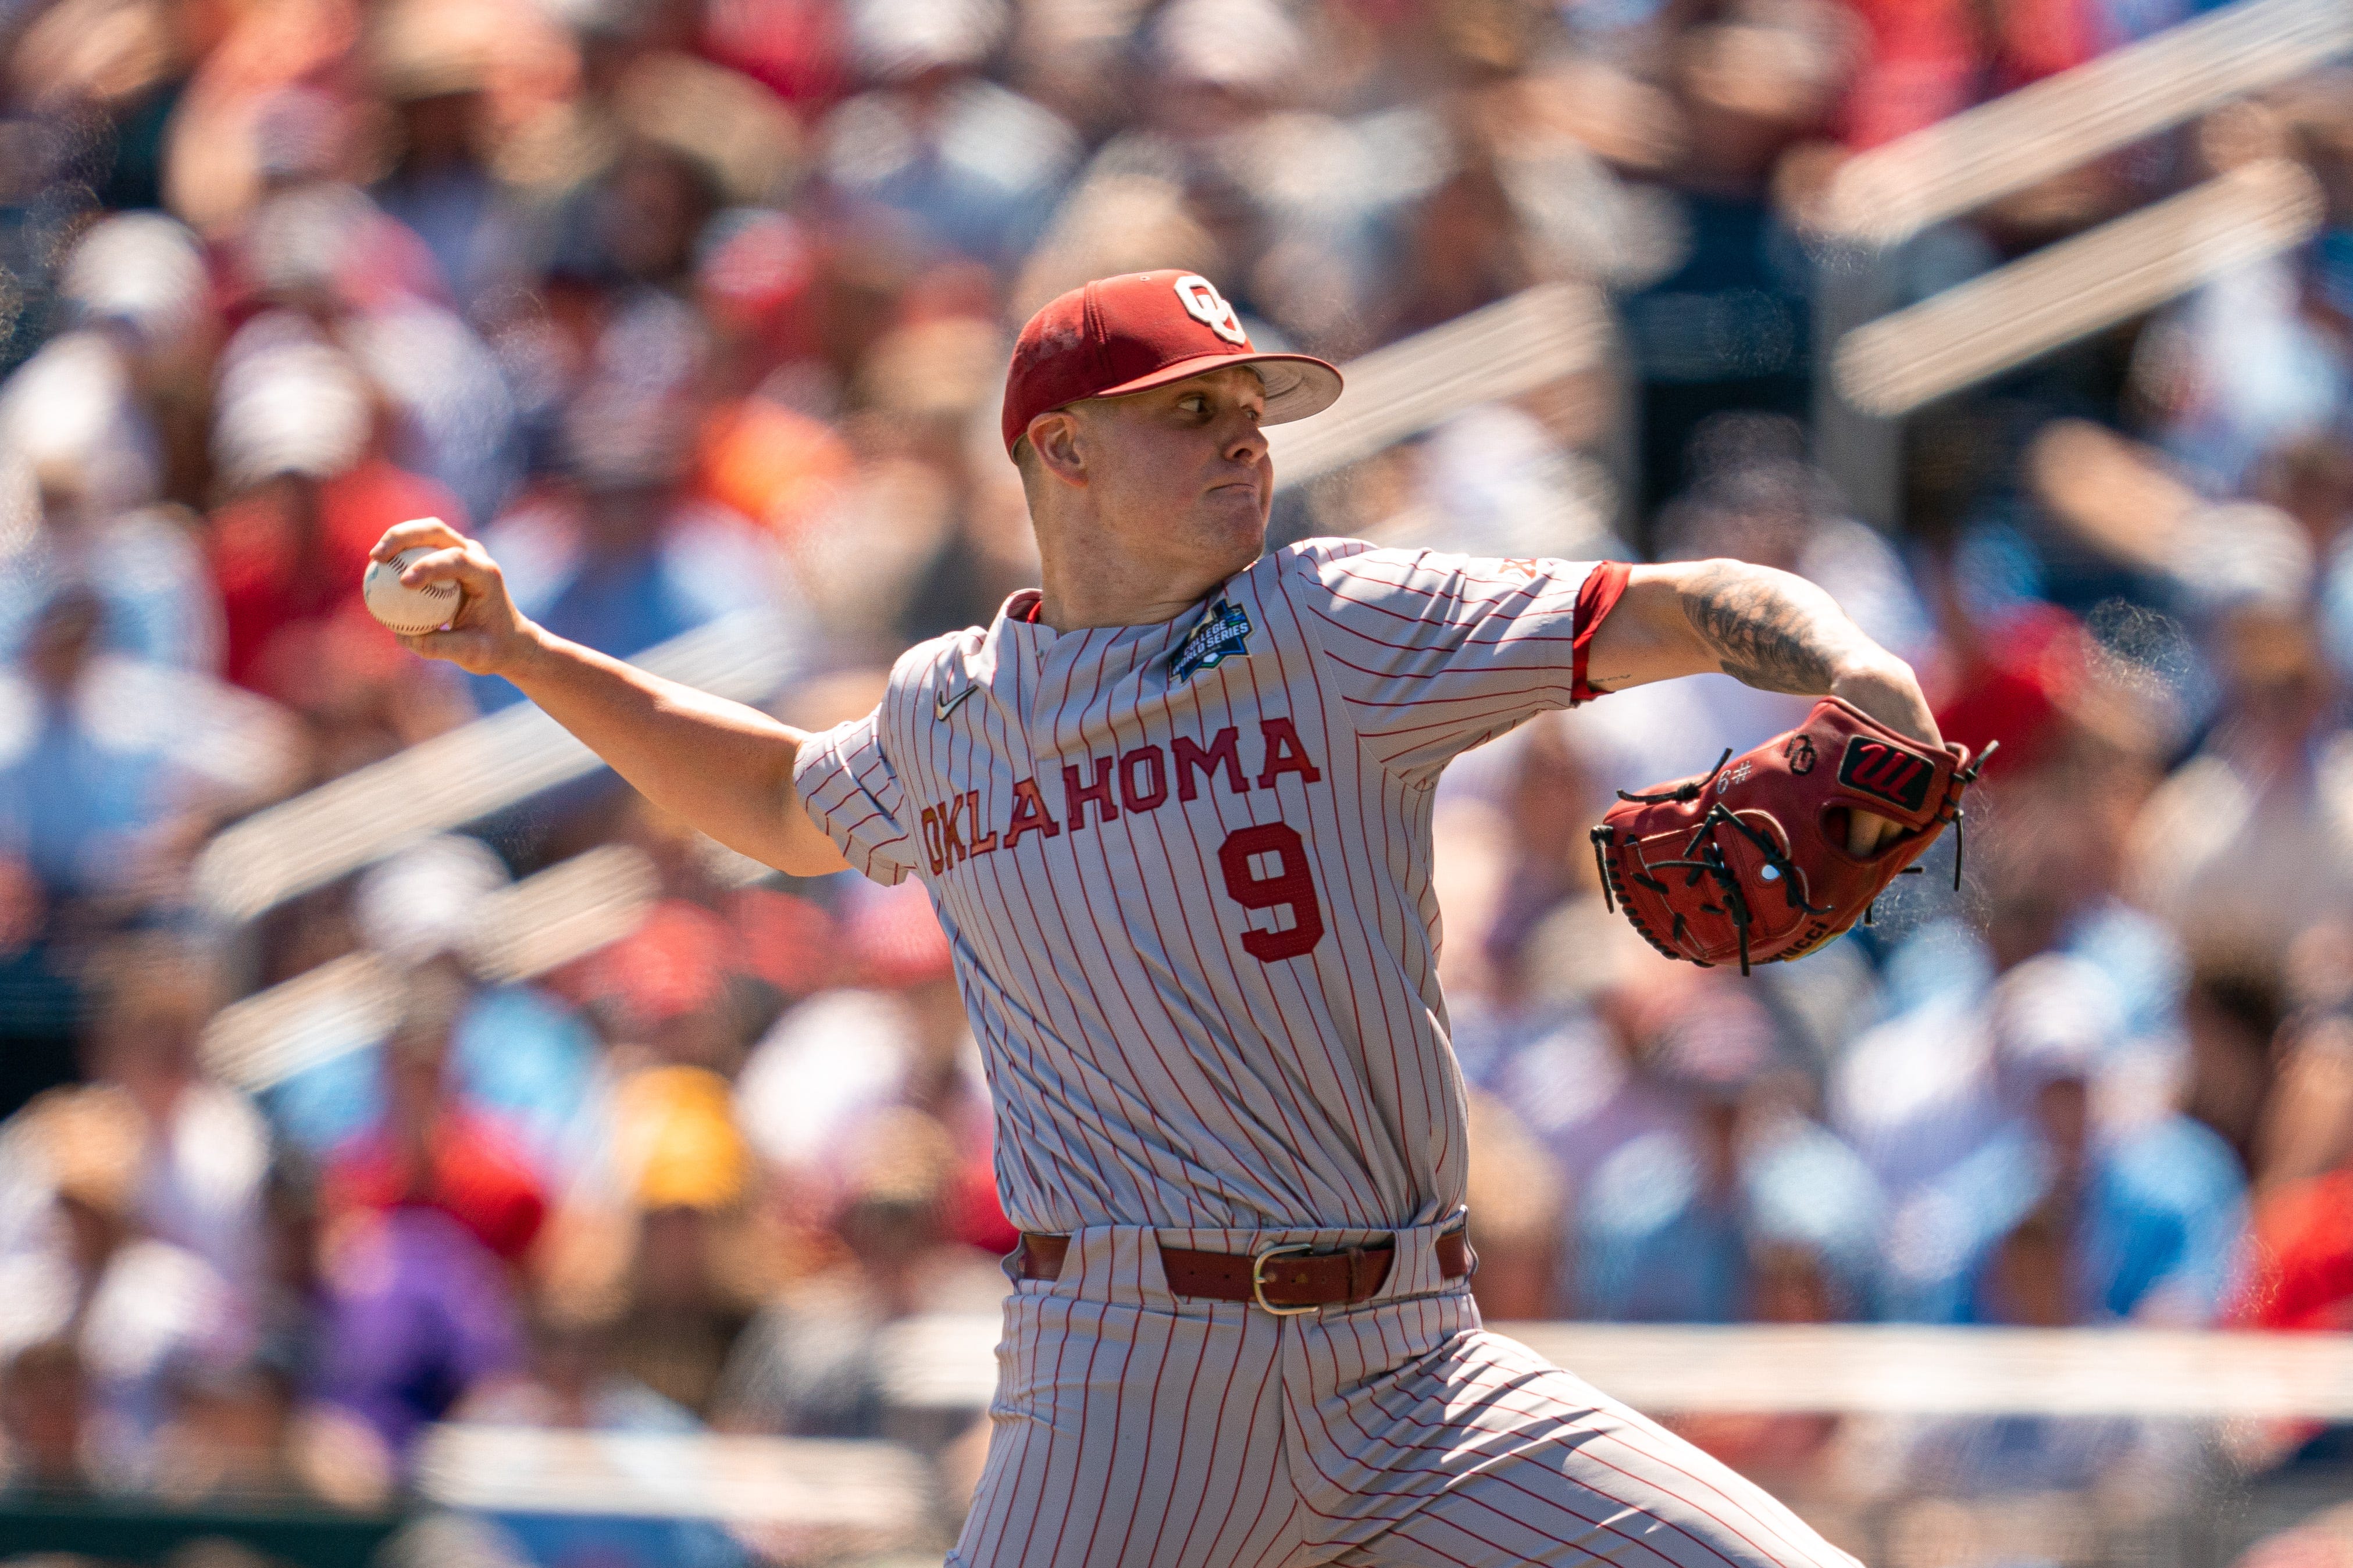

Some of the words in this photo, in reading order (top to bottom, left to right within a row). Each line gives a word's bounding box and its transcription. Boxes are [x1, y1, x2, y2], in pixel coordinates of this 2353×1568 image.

[1206, 622, 1249, 648] SERIES
[921, 717, 1321, 876] OKLAHOMA
[1217, 821, 1324, 963] 9
